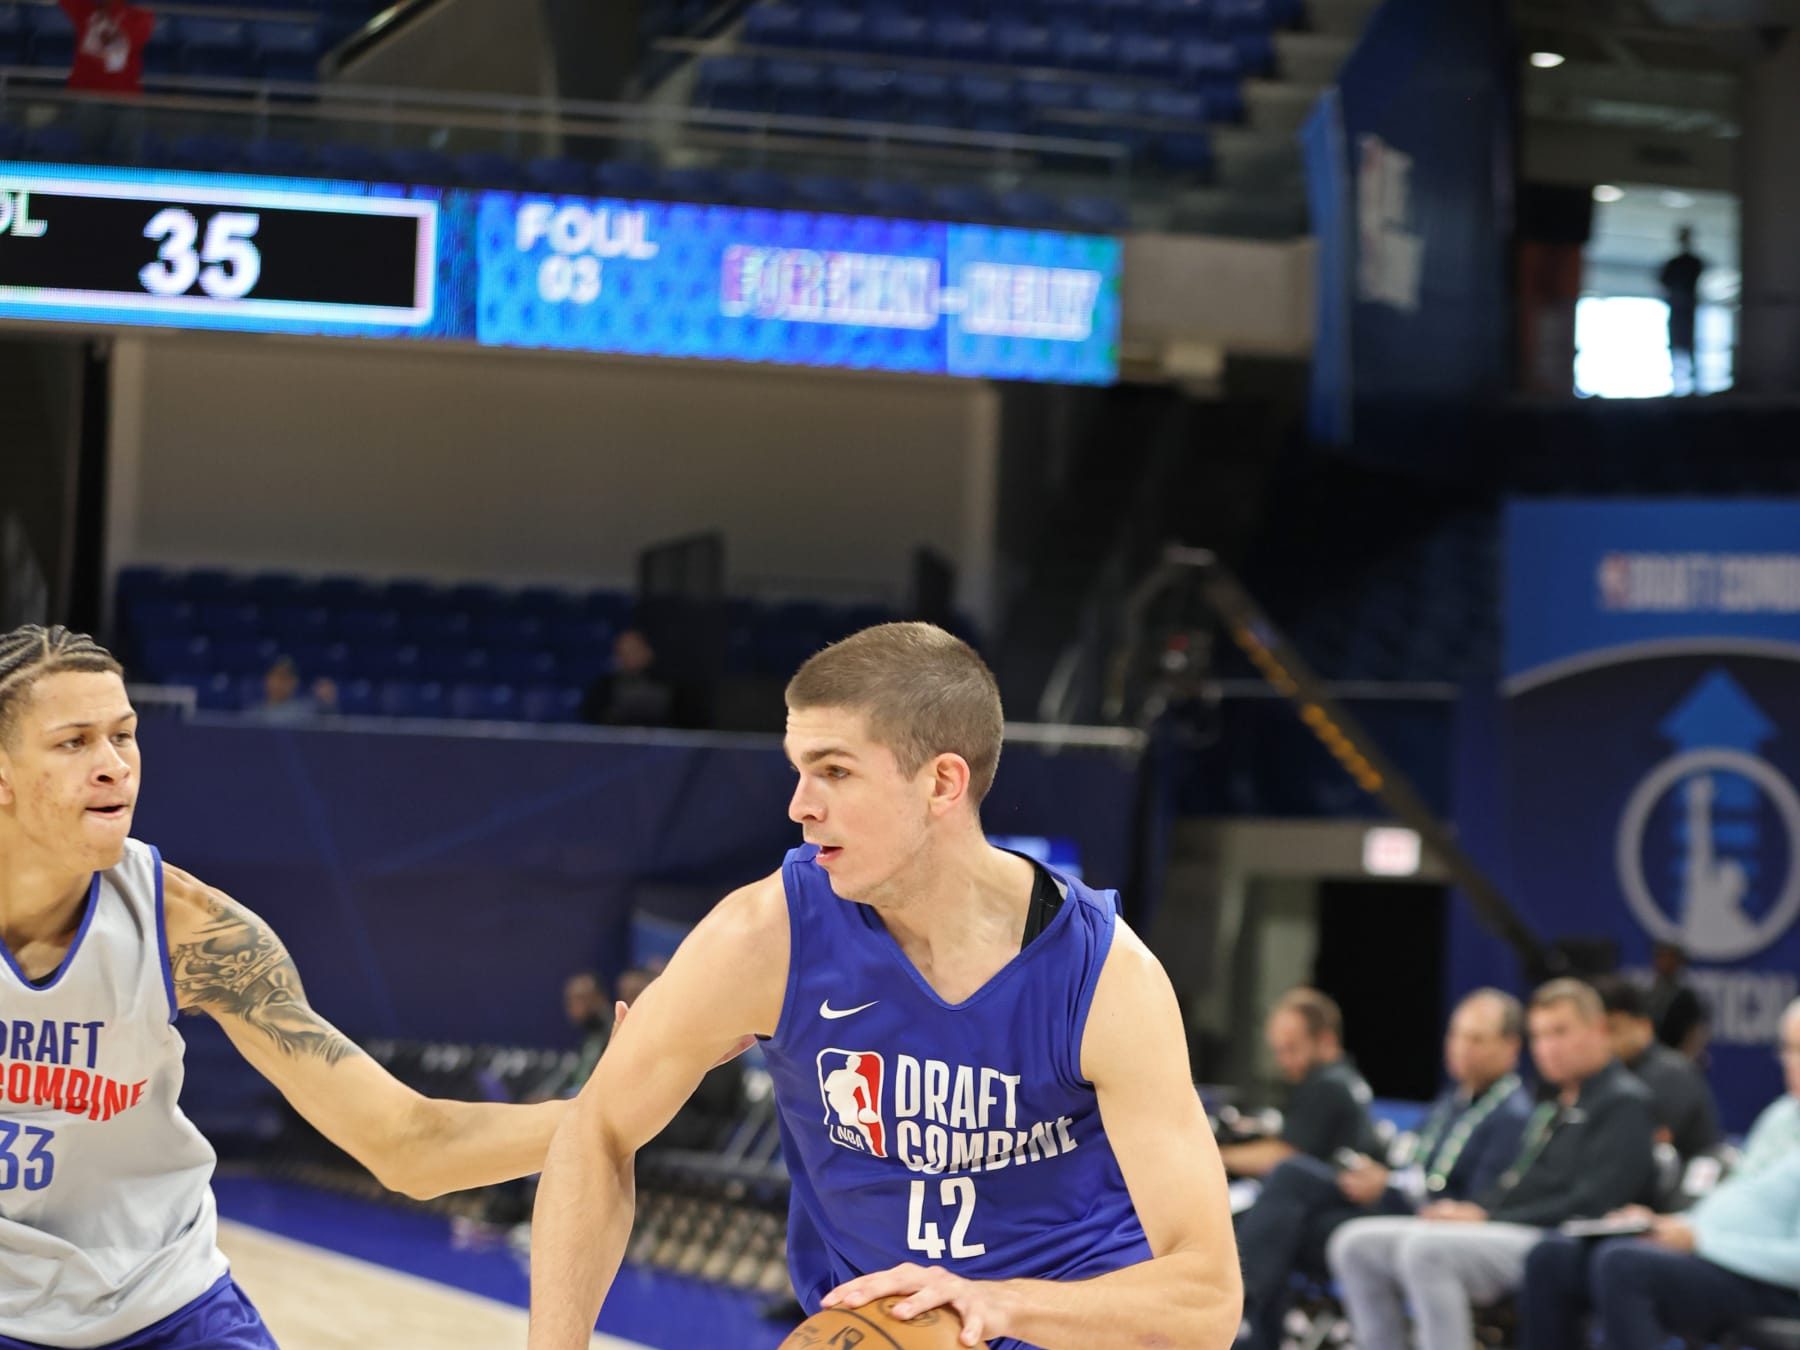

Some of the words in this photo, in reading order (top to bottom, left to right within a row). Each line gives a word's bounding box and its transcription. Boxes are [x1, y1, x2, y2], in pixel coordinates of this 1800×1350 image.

[138, 207, 261, 298] 35
[515, 202, 660, 260] FOUL
[537, 254, 603, 304] 03
[0, 1062, 148, 1122] OMBINE
[895, 1054, 1021, 1130] DRAFT
[0, 1119, 55, 1191] 33
[837, 1125, 865, 1150] NBA
[896, 1115, 1078, 1175] COMBINE
[907, 1176, 985, 1259] 42
